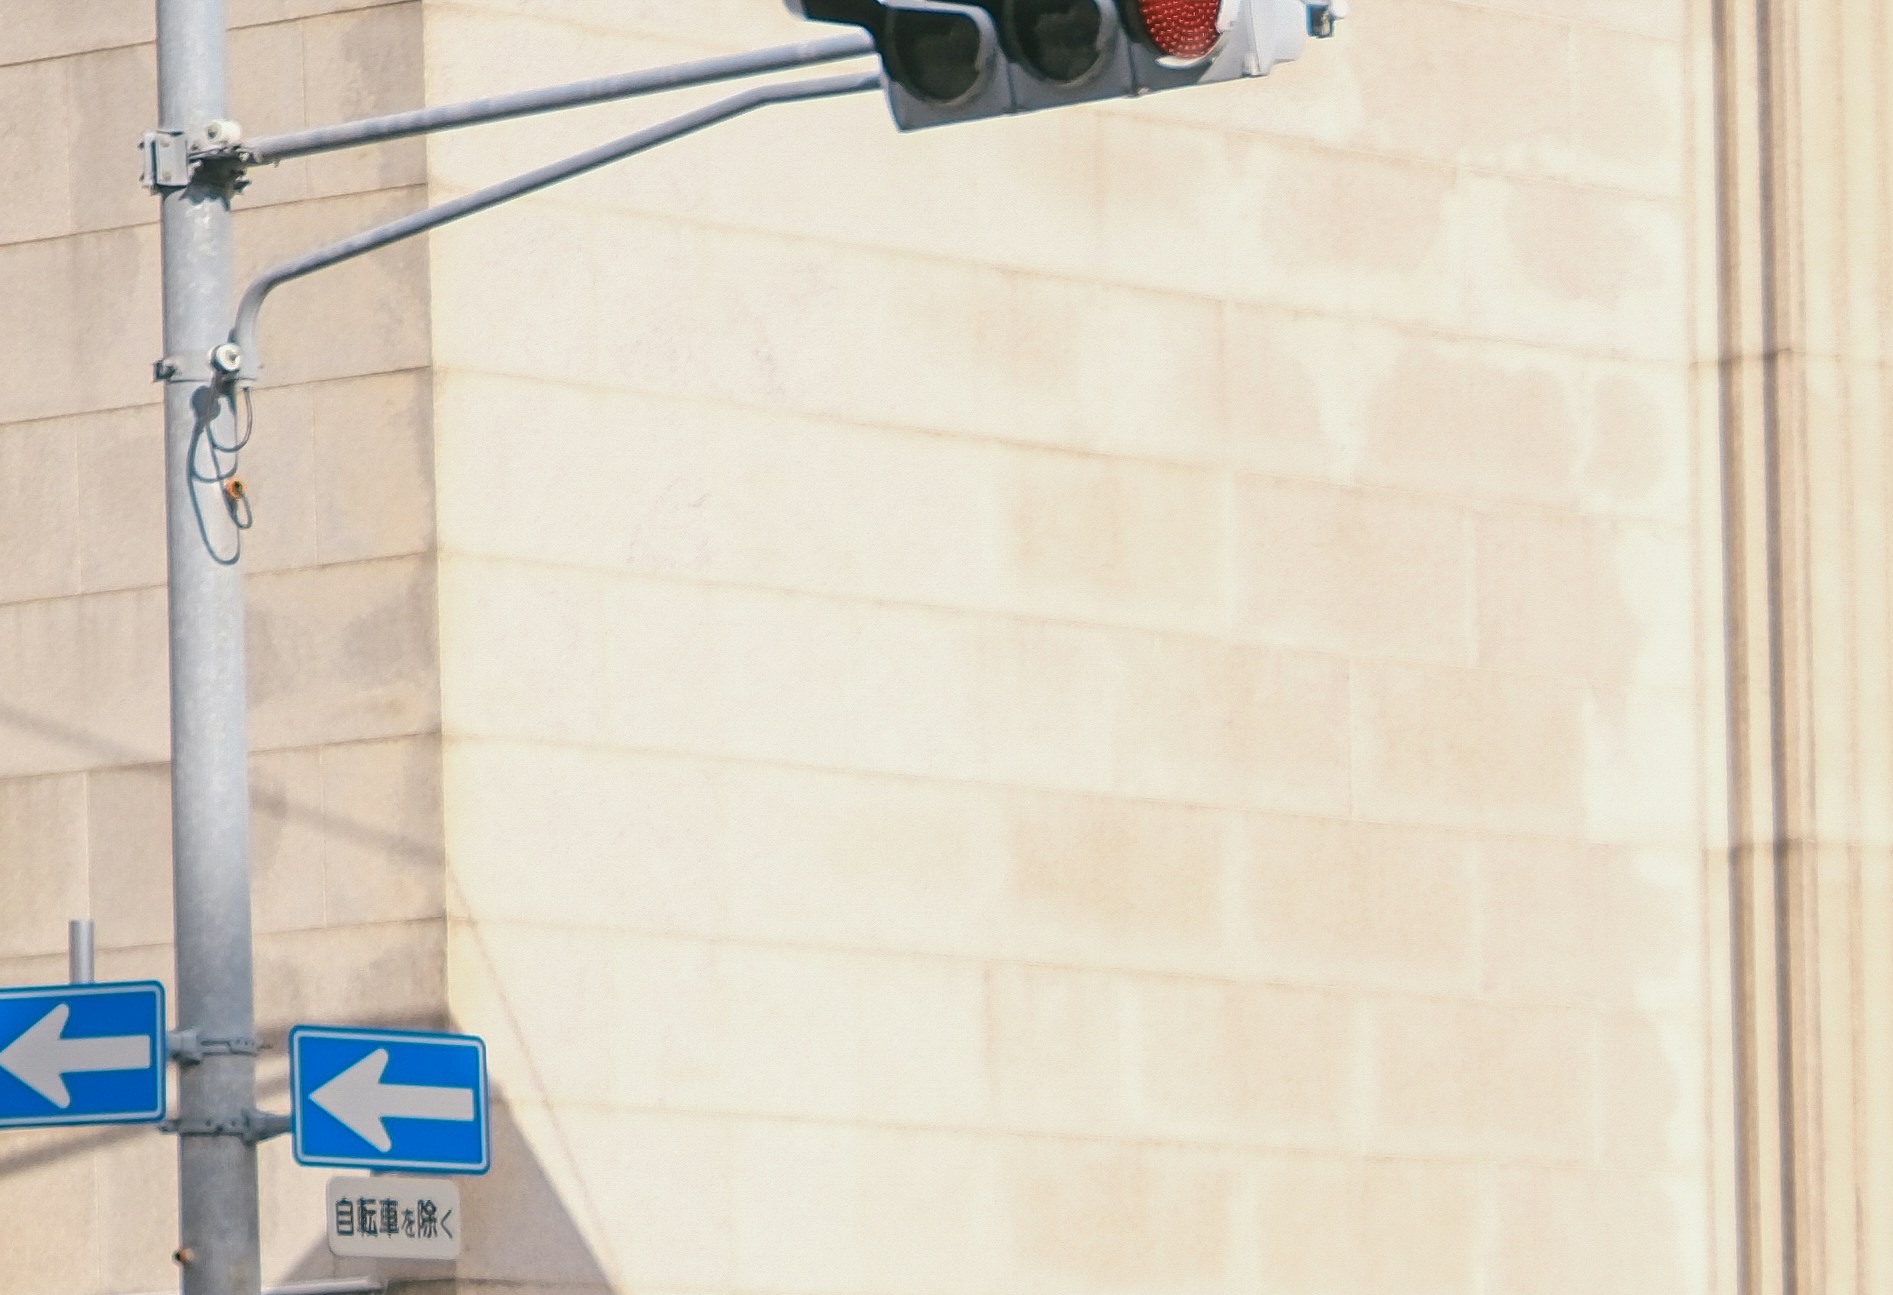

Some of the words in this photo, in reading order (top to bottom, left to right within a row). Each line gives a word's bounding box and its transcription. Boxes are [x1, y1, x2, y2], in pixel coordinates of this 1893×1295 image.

[335, 1197, 453, 1239] 自転車を除く
